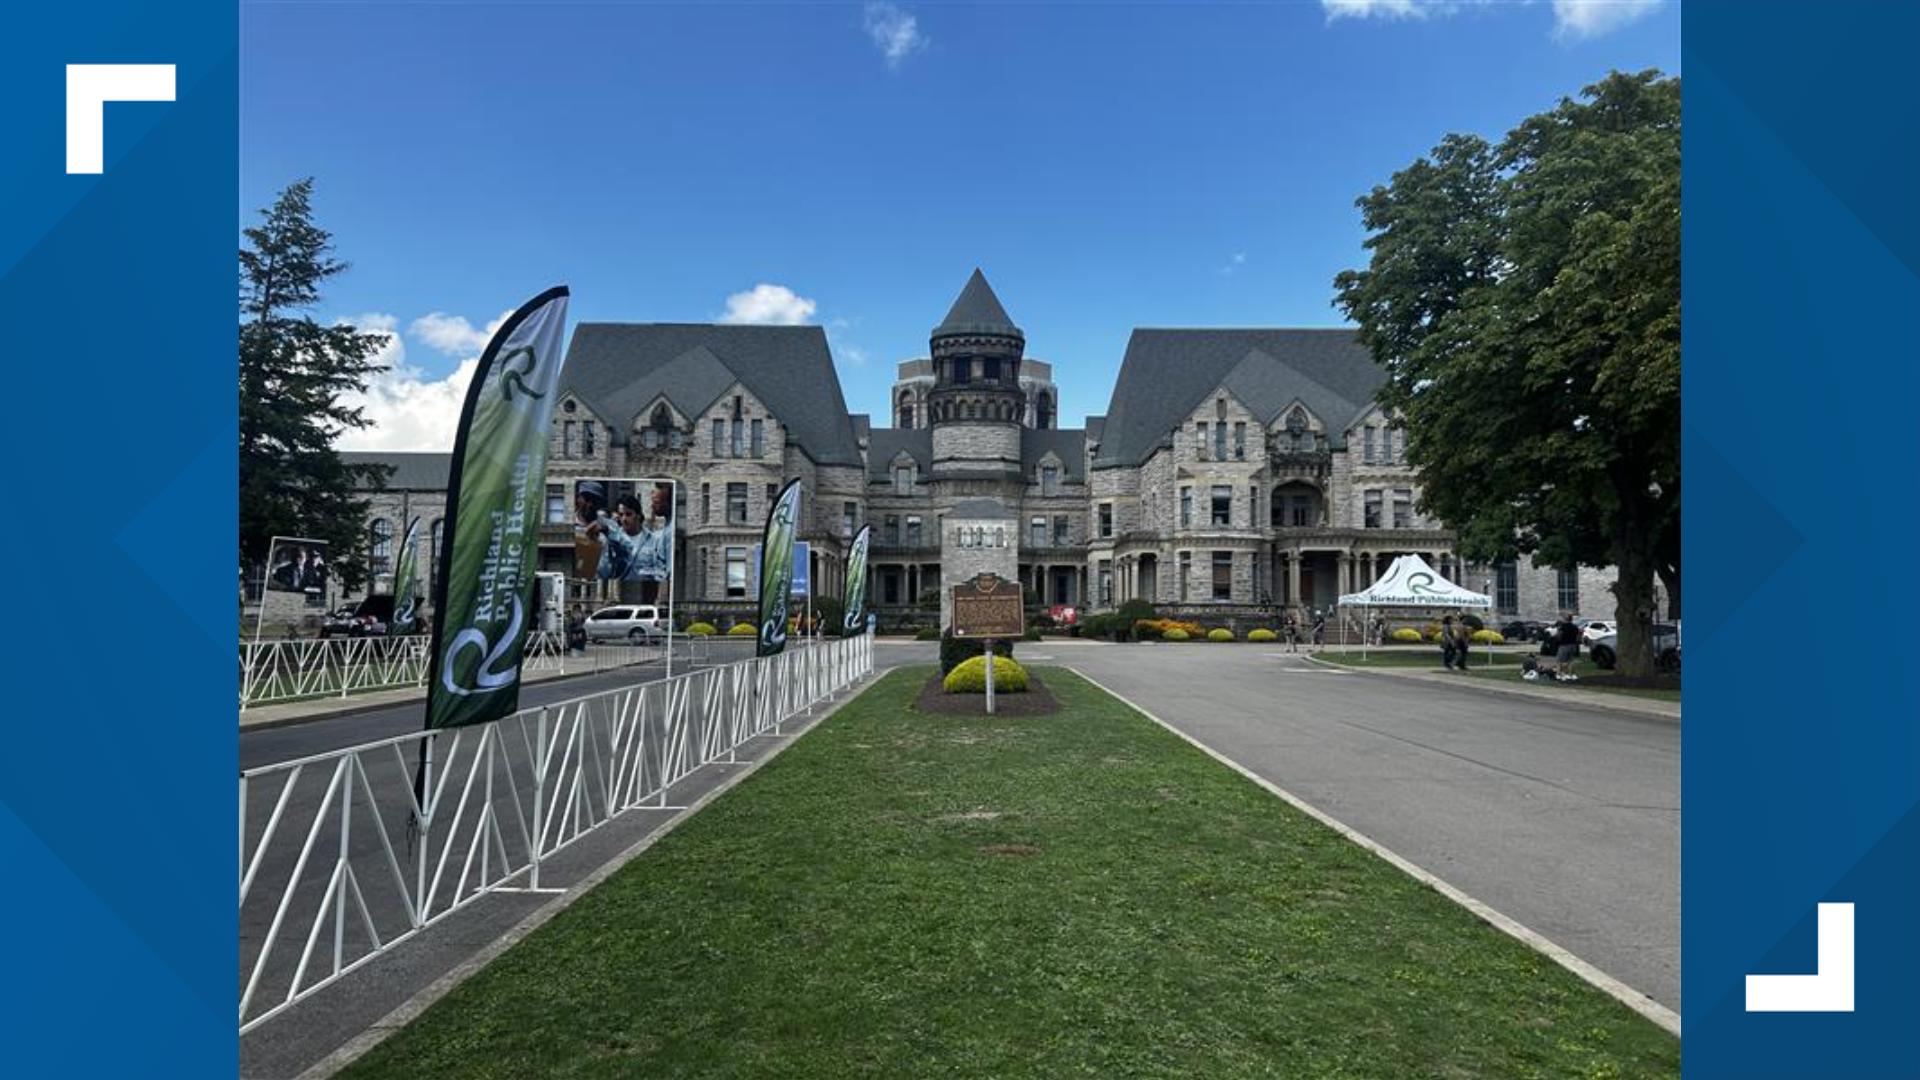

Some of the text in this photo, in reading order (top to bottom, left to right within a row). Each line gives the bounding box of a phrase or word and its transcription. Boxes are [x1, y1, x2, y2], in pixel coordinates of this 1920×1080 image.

[474, 510, 503, 622] Richland
[495, 453, 529, 621] Public Health
[1370, 595, 1489, 606] Richland Public Health
